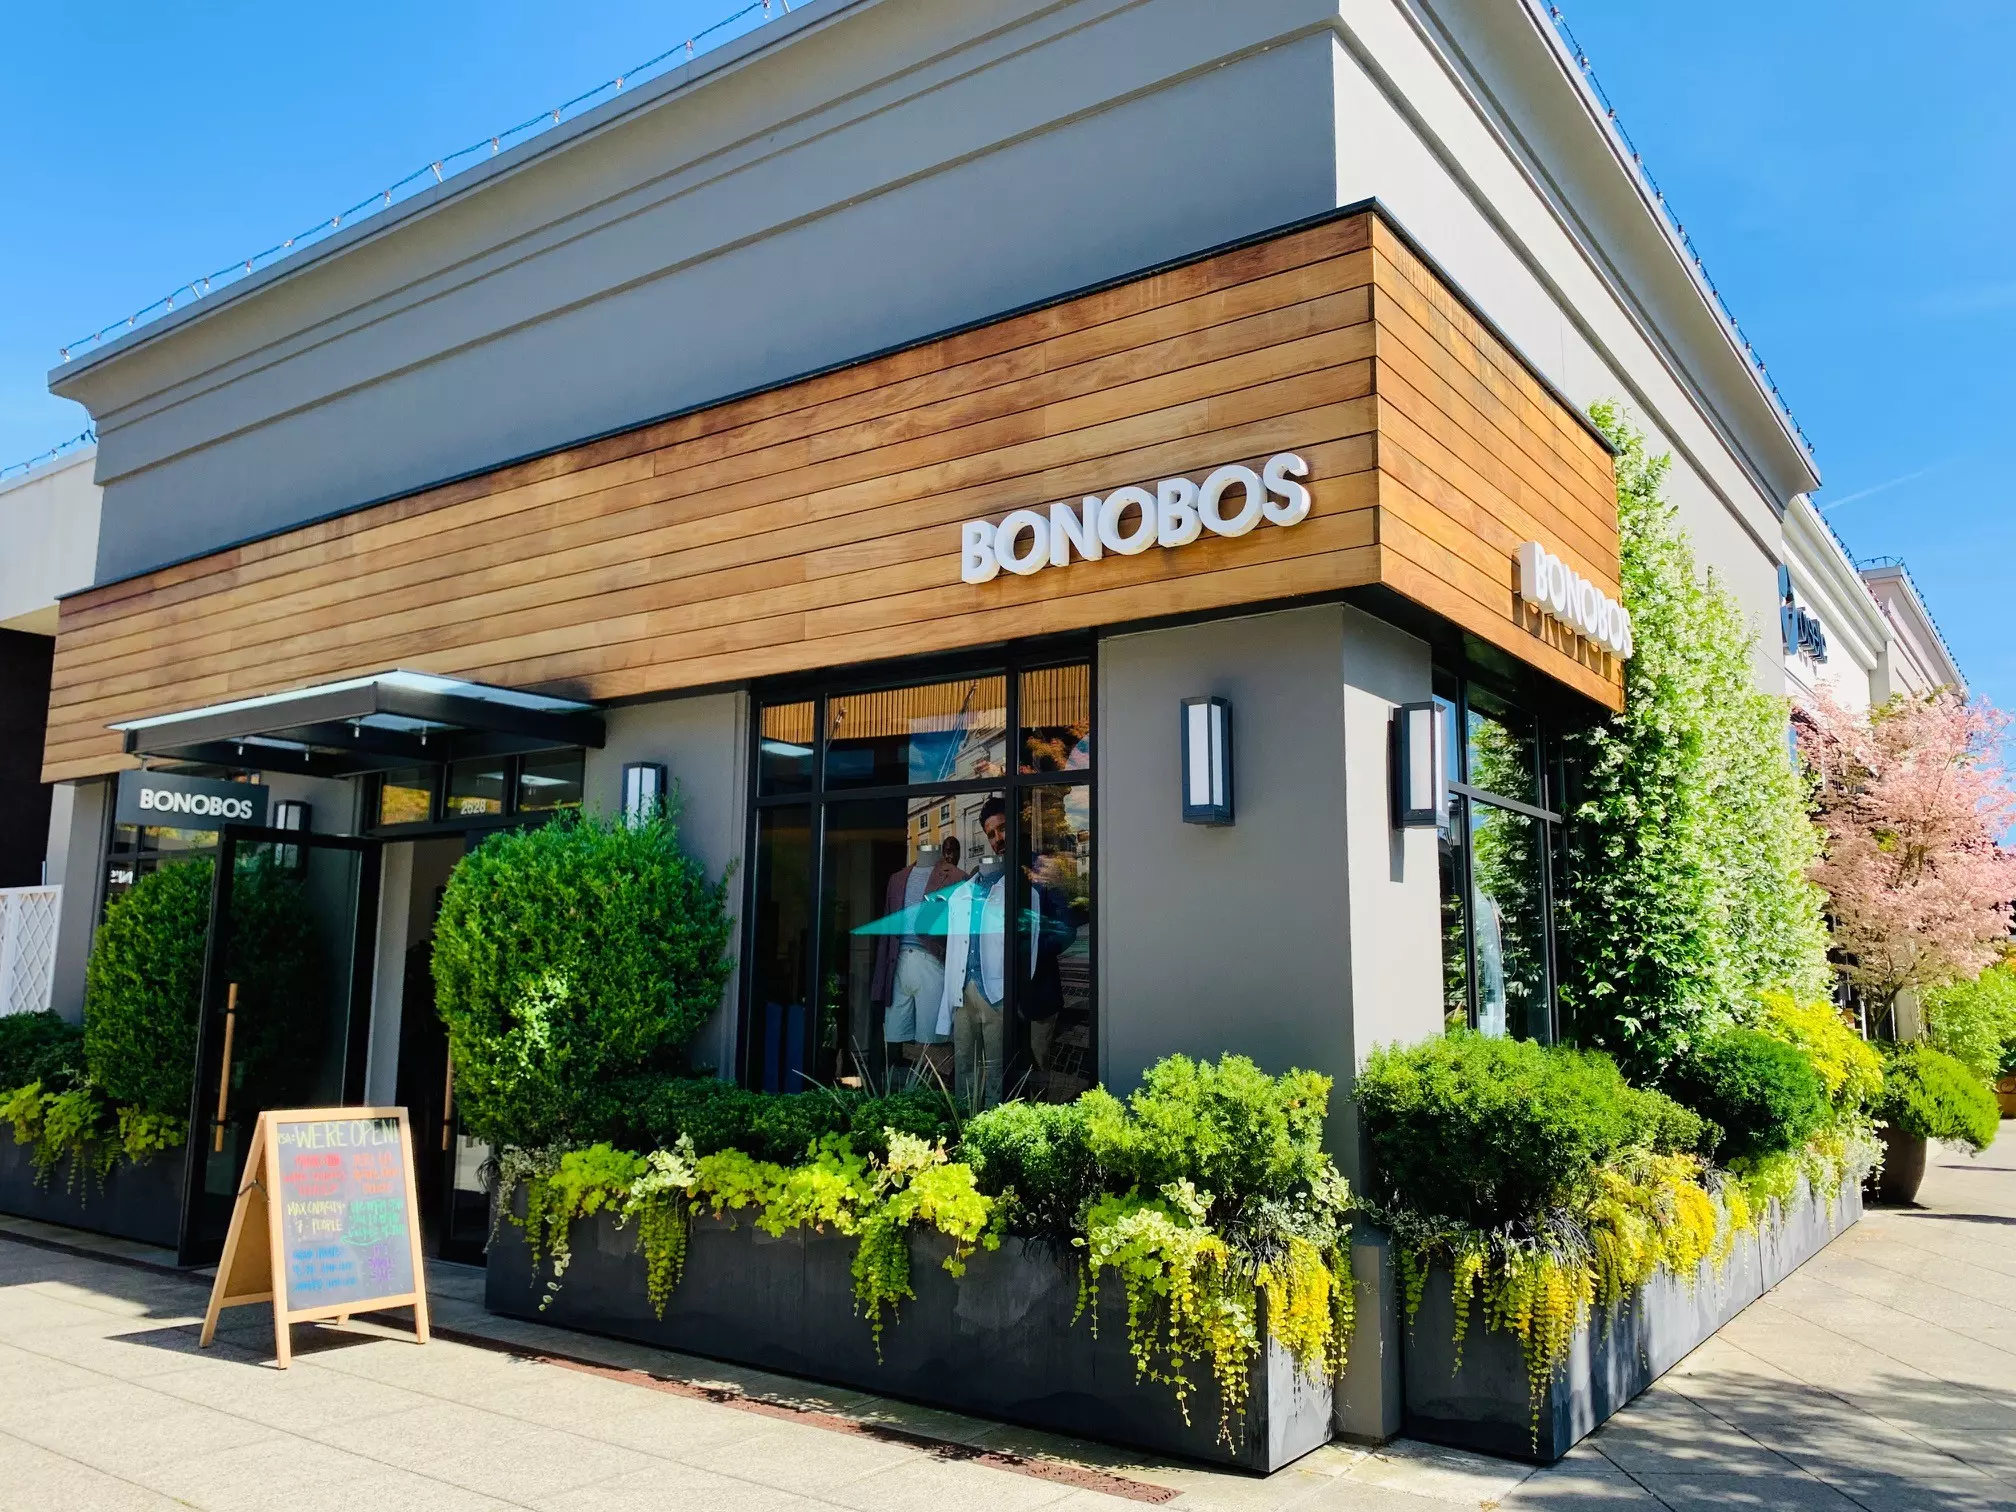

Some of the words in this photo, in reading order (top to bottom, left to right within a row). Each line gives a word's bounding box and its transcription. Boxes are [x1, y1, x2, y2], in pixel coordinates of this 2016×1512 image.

[961, 452, 1311, 584] BONOBOS
[1520, 540, 1633, 659] BONOBOS
[140, 788, 253, 820] BONOBOS
